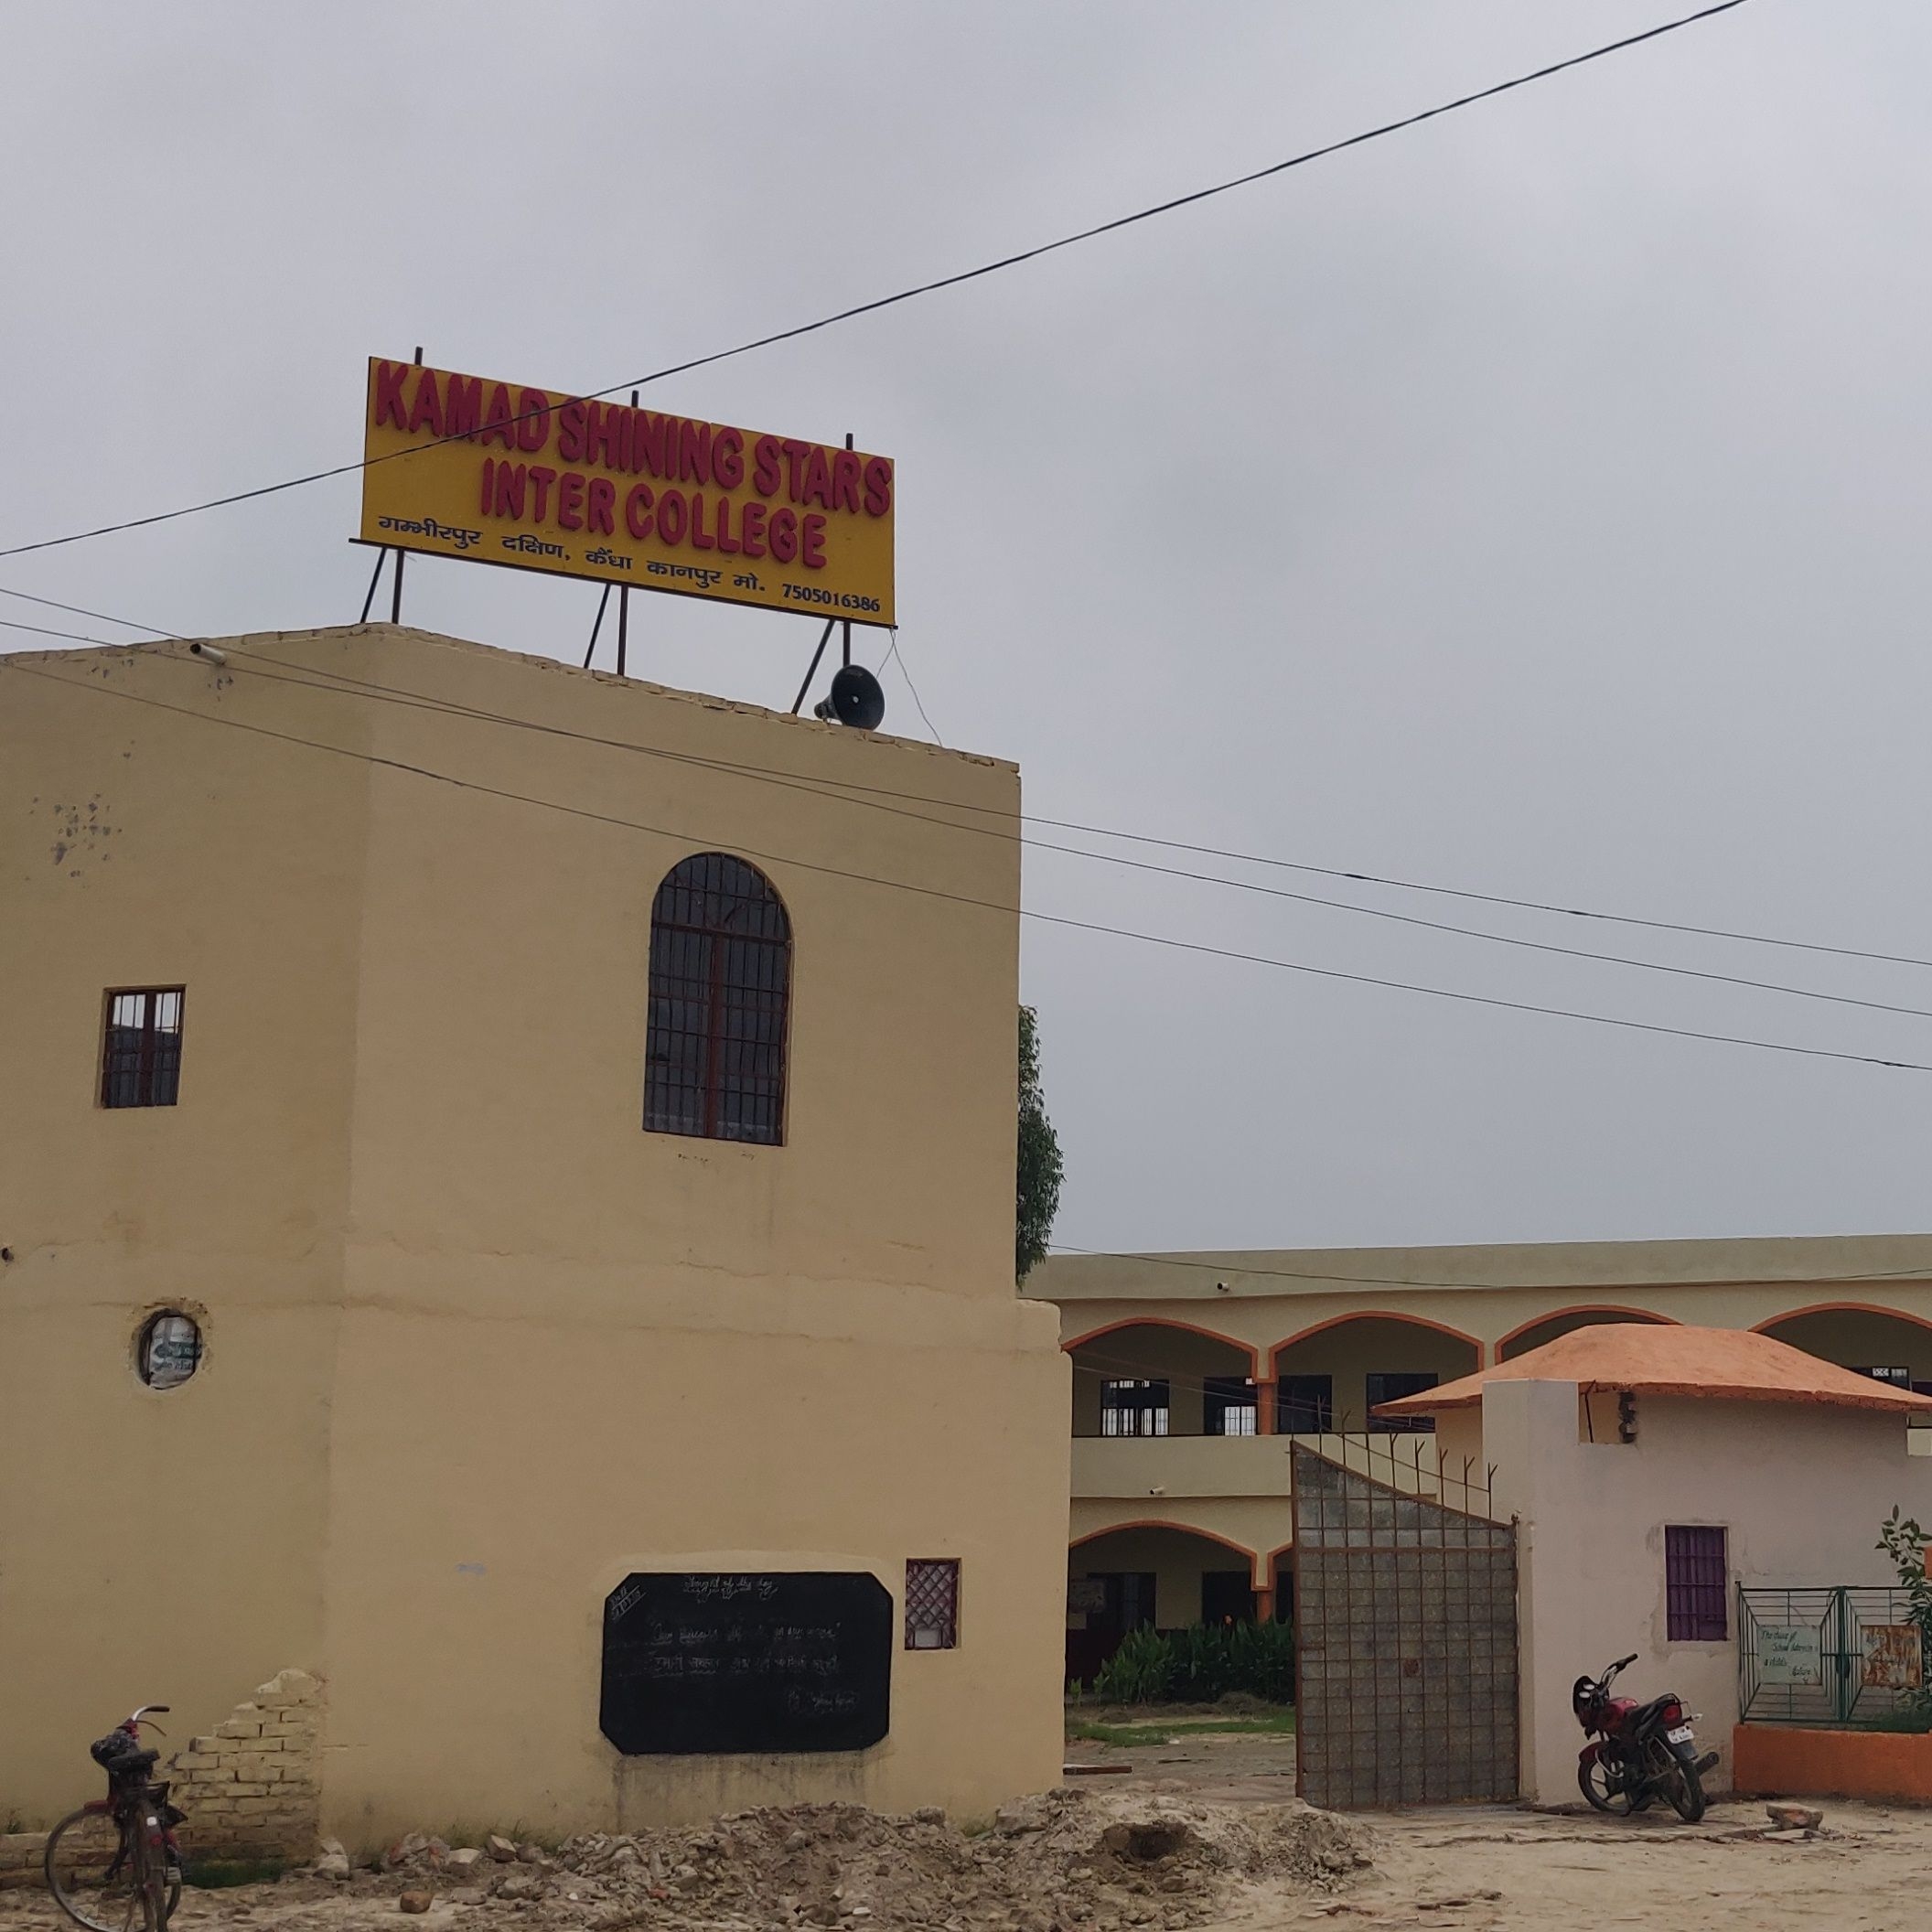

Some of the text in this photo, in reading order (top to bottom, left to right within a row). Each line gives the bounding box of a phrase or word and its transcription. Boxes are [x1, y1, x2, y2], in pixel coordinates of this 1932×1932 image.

[375, 360, 893, 518] KAMAD SHINING STARS
[480, 457, 828, 569] INTER COLLEGE
[646, 560, 723, 588] कानपुर
[733, 572, 766, 592] मो.
[782, 583, 880, 613] 7505016386
